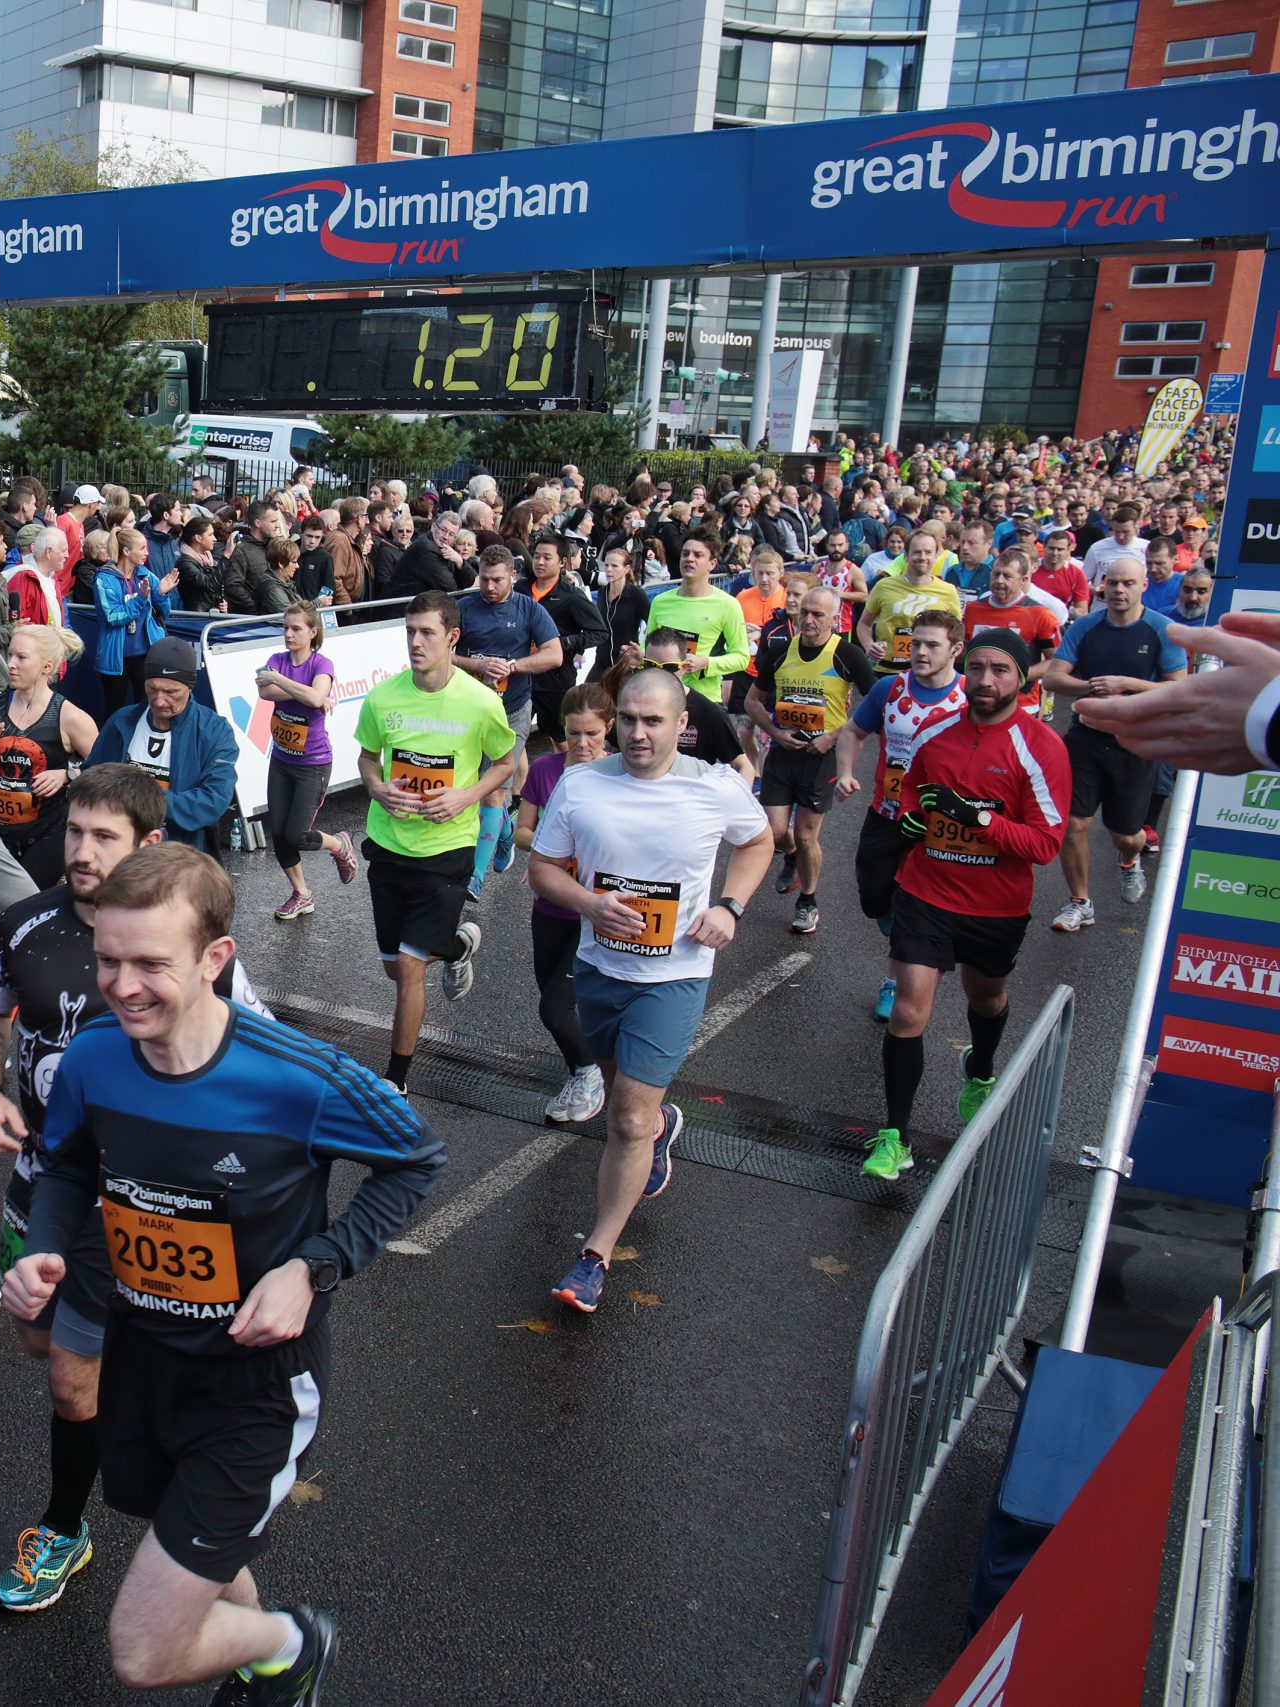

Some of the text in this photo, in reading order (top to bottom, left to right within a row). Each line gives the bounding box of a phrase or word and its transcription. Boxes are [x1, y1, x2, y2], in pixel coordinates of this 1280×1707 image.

[810, 108, 1280, 209] great birmingh
[230, 175, 588, 247] great birmingham
[1066, 191, 1167, 229] run
[398, 237, 460, 265] run
[631, 328, 832, 350] maew boulton campus
[1165, 387, 1198, 399] FAST
[1155, 398, 1199, 410] PACED
[1152, 410, 1186, 422] CLUB
[1147, 422, 1185, 430] RUNNERS
[194, 429, 270, 447] enterprise
[239, 444, 269, 452] rent-a-car
[781, 686, 824, 695] STRIDERS
[789, 679, 825, 687] ALBANS
[781, 709, 818, 724] 3607
[273, 726, 301, 745] 4202
[0, 755, 31, 767] LAURA
[968, 800, 995, 809] ingham
[1217, 808, 1279, 830] Holiday
[925, 848, 995, 865] BIRMINGHAM
[602, 877, 672, 894] great birmingham
[620, 899, 650, 908] ARETH
[595, 934, 670, 956] BIRMINGHAM
[1196, 1042, 1280, 1067] ATHLETICS
[1241, 1061, 1278, 1073] WEEKLY
[213, 1164, 246, 1173] adidas
[106, 1178, 213, 1210] great birmingham
[153, 1205, 176, 1216] run
[138, 1216, 175, 1233] MARK
[113, 1227, 216, 1282] 2033
[140, 1277, 171, 1293] PUMA
[115, 1279, 235, 1319] BIRMINGHAM
